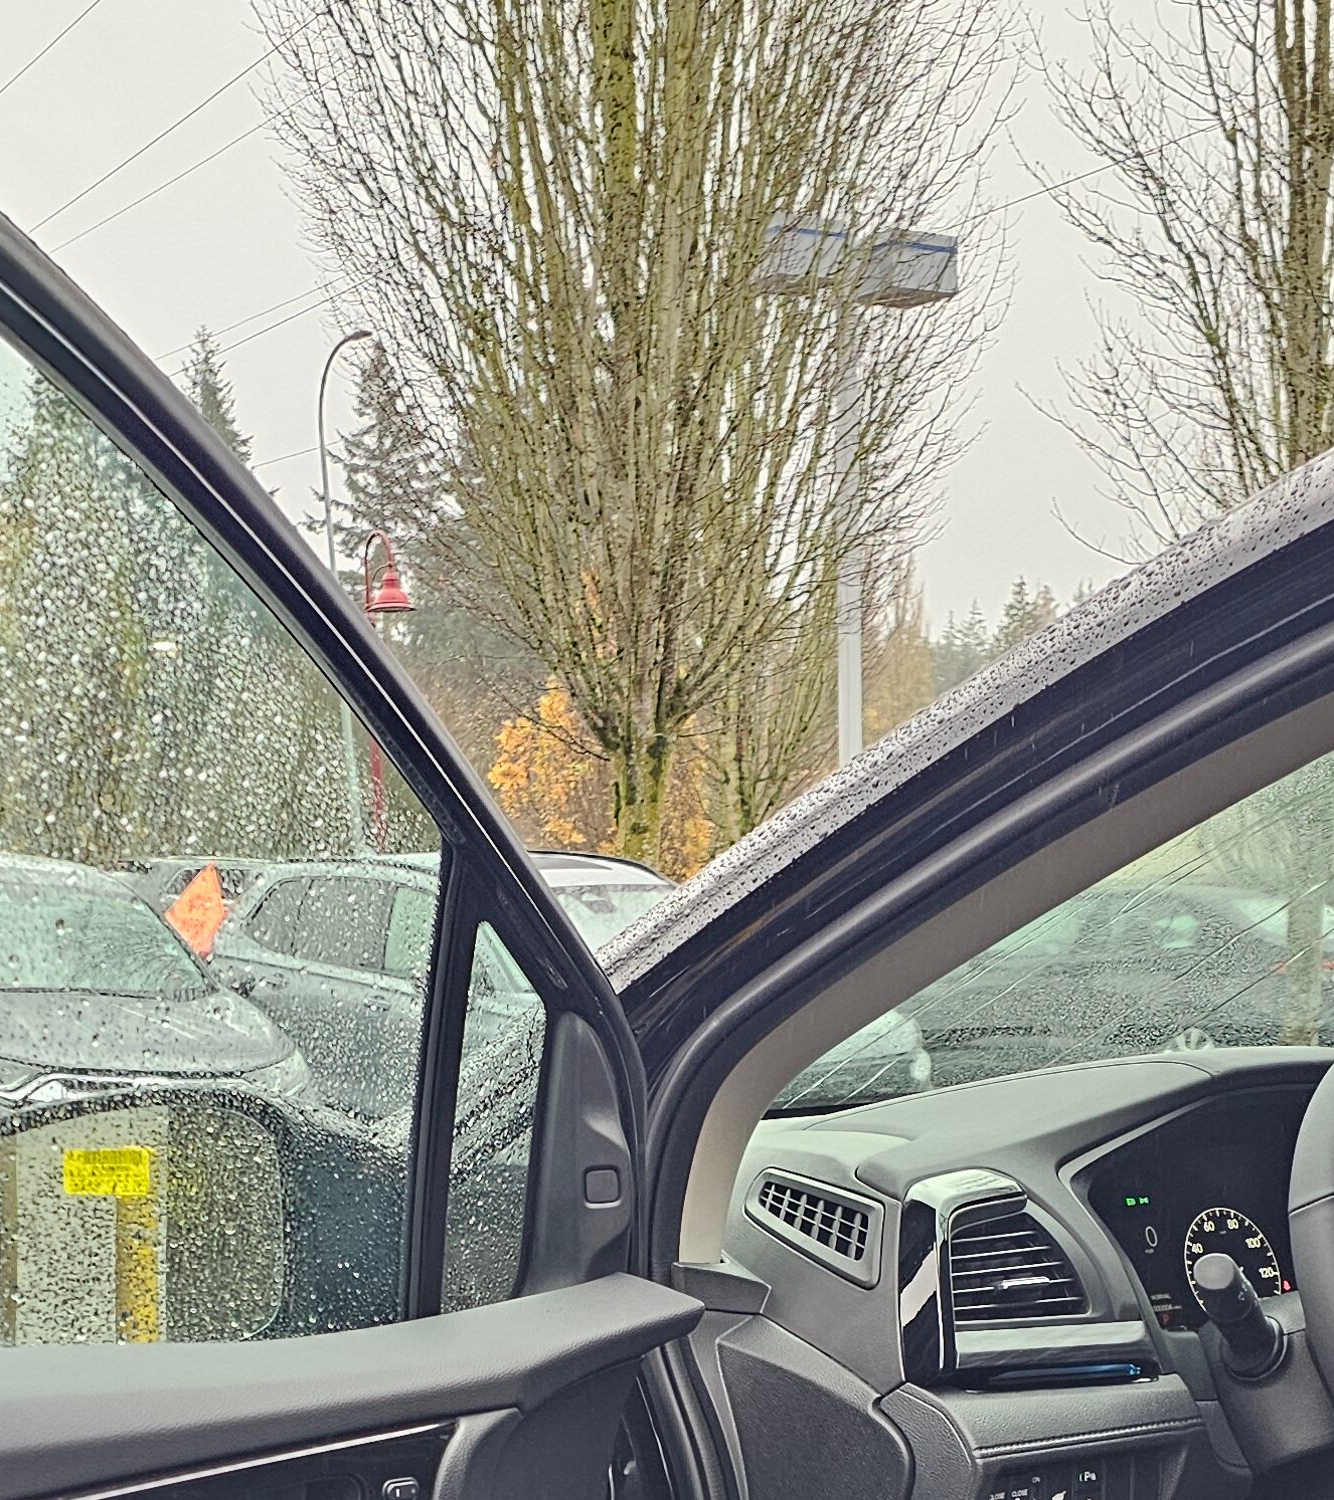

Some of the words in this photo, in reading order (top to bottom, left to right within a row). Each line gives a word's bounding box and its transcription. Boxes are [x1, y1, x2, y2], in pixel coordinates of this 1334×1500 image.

[1203, 1221, 1215, 1232] 60
[1227, 1218, 1239, 1230] 80
[1245, 1237, 1261, 1249] 100
[1259, 1266, 1274, 1278] 120
